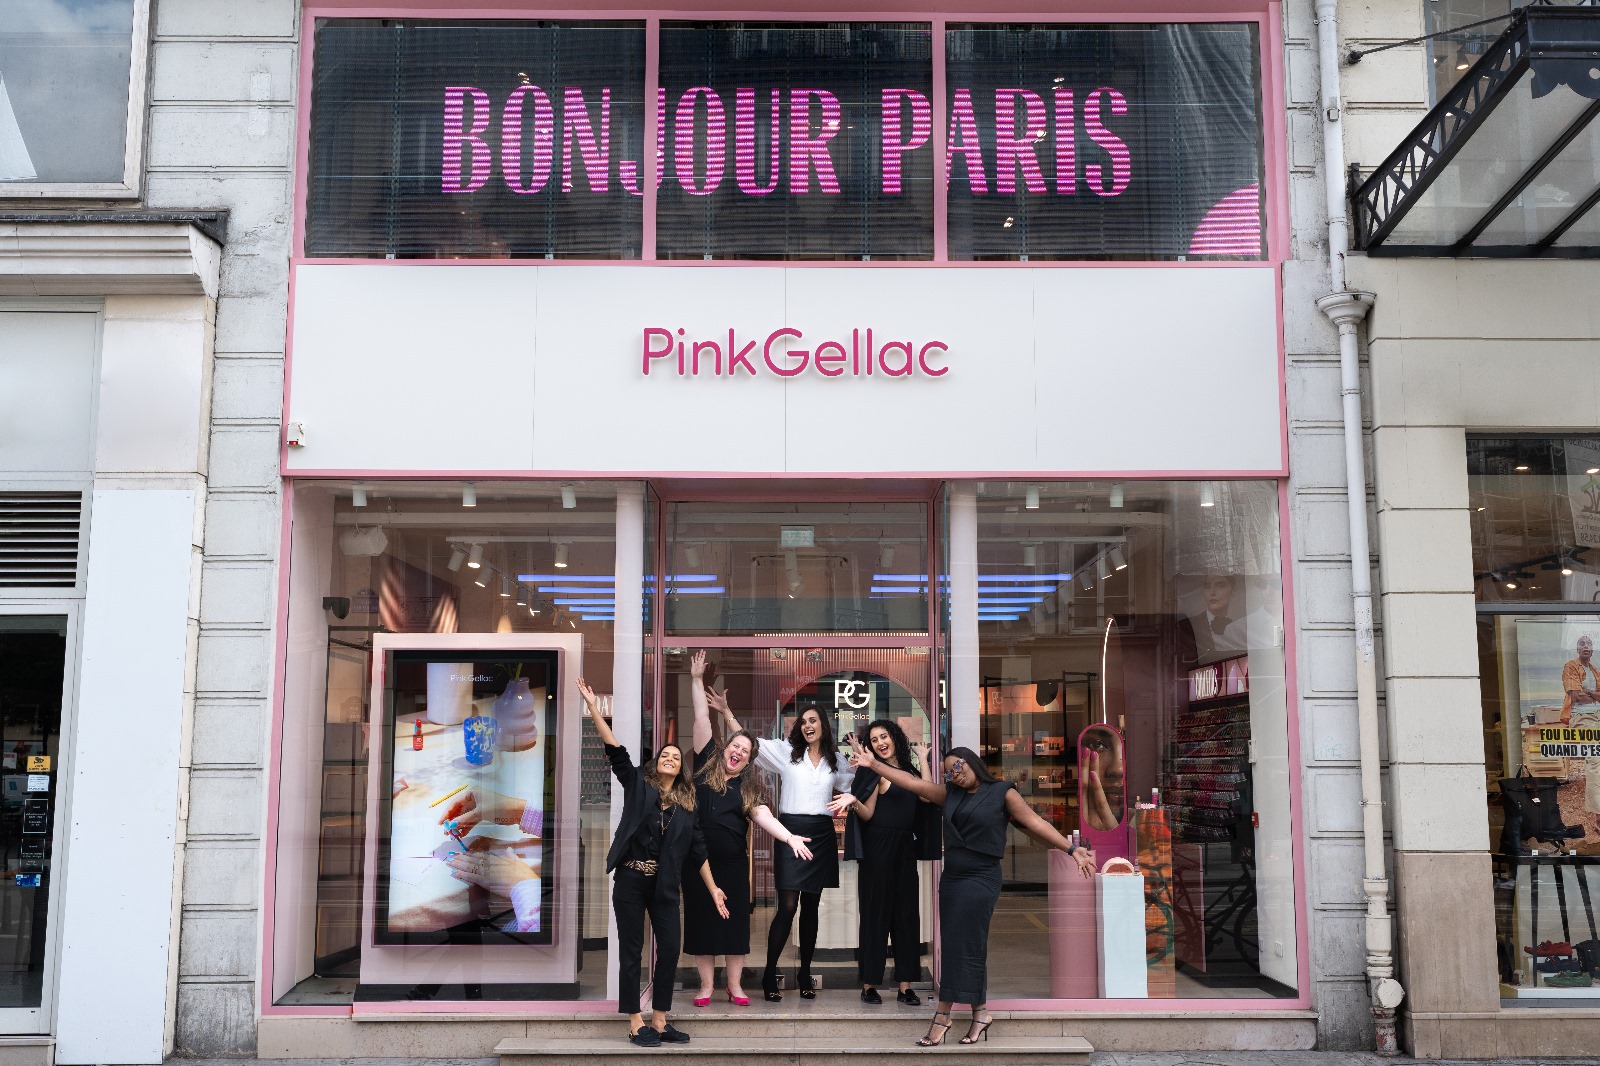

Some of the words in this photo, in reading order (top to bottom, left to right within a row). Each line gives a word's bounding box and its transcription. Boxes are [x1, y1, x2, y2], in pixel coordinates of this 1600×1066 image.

[442, 87, 841, 196] BONJOUR
[882, 87, 1132, 197] PARIS
[643, 328, 949, 377] PinkGellac
[834, 679, 870, 709] PG
[1540, 729, 1560, 741] FOU
[1563, 729, 1576, 741] DE
[1541, 744, 1578, 758] QUAND
